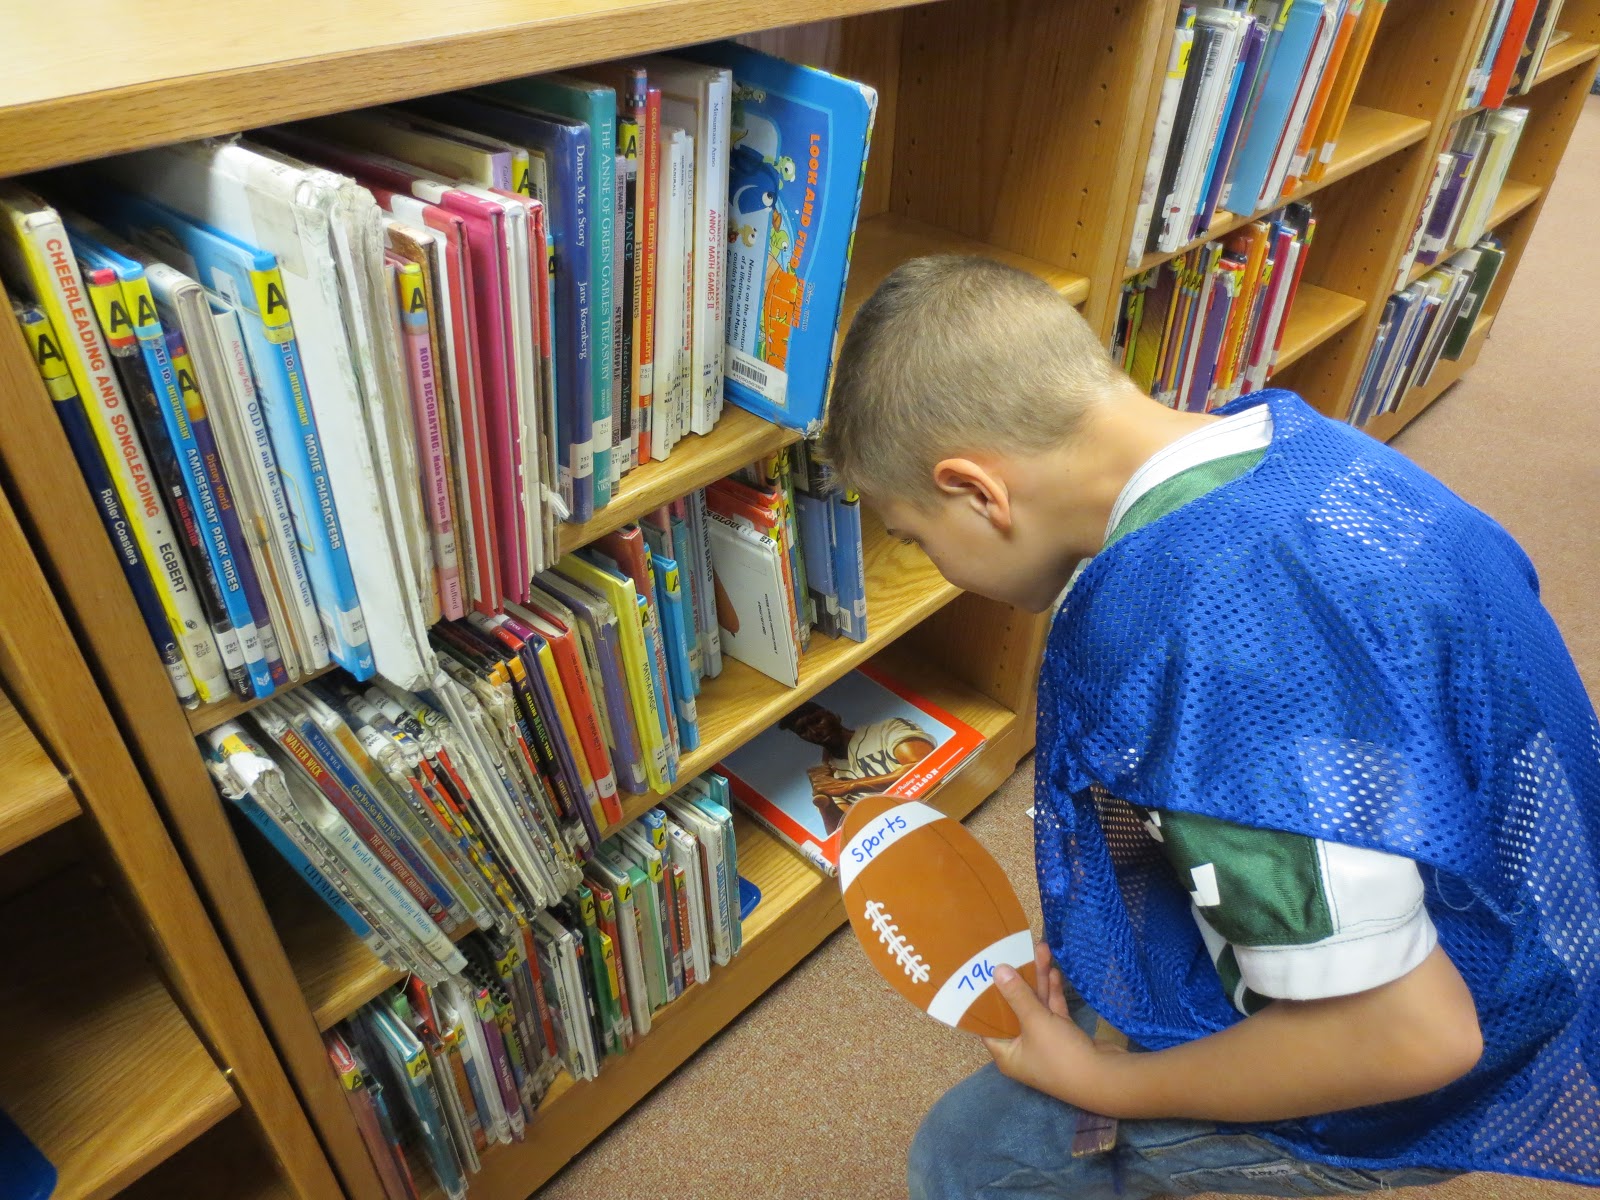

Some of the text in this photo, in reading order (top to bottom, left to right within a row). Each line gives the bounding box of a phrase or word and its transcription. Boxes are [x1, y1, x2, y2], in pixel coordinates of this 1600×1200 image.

[576, 144, 586, 182] Dance
[626, 135, 637, 158] A
[517, 168, 529, 194] A
[576, 186, 586, 204] Me
[790, 133, 820, 268] LOOK AND FIND
[576, 217, 587, 248] Story
[600, 118, 612, 380] THE ANNE OF GREEN GABLES TREASURY
[626, 207, 634, 261] DANCE
[730, 252, 738, 284] couldn't
[740, 256, 746, 264] of
[747, 258, 755, 284] Nemo
[267, 282, 288, 314] A
[632, 242, 642, 318] Hand Rhymes
[730, 284, 736, 294] be
[737, 270, 745, 302] lifetime,
[745, 292, 750, 302] on
[110, 300, 133, 332] A
[138, 294, 158, 328] A
[410, 287, 426, 314] A
[792, 278, 806, 329] FINDING
[578, 282, 588, 360] Jane Rosenberg
[37, 333, 64, 366] A
[419, 347, 431, 378] ROOM
[614, 306, 622, 381] STUNTPEOPLE
[178, 369, 200, 398] A
[288, 372, 311, 427] ENTERTAINMENT
[46, 238, 188, 594] CHEERLEADING AND SONGLEADING EGBERT
[166, 384, 191, 440] ENTERTAINMENT
[424, 382, 440, 454] DECORATING:
[206, 454, 230, 511] Disney World
[433, 455, 442, 476] Make
[248, 401, 312, 608] OLD BET and the Start of the American Circus
[304, 434, 340, 550] MOVIE CHARACTERS
[436, 476, 444, 495] Your
[101, 488, 138, 566] Roller Coasters
[172, 486, 200, 548] BIG ROLLER COASTERS
[186, 448, 240, 593] AMUSEMENT PARK RIDES
[438, 496, 448, 522] Space
[700, 504, 713, 582] SKATING BASICS
[642, 611, 650, 628] A
[642, 662, 656, 713] MATH-A-MAGIC
[518, 719, 532, 746] MAGIC
[524, 692, 554, 760] AMAZING MAGIC TRICKS
[285, 733, 324, 778] WALTER WICK
[312, 734, 342, 772] WALTER WICK
[904, 768, 939, 798] NELSON
[851, 814, 908, 863] sports
[304, 862, 348, 910] CITYMAZE!
[338, 826, 433, 935] The World's Most Challenging Puzzles
[370, 834, 430, 904] THE NIGHT BEFORE CHRISTMAS
[586, 900, 594, 914] A
[957, 959, 997, 992] 796
[352, 1074, 363, 1090] A
